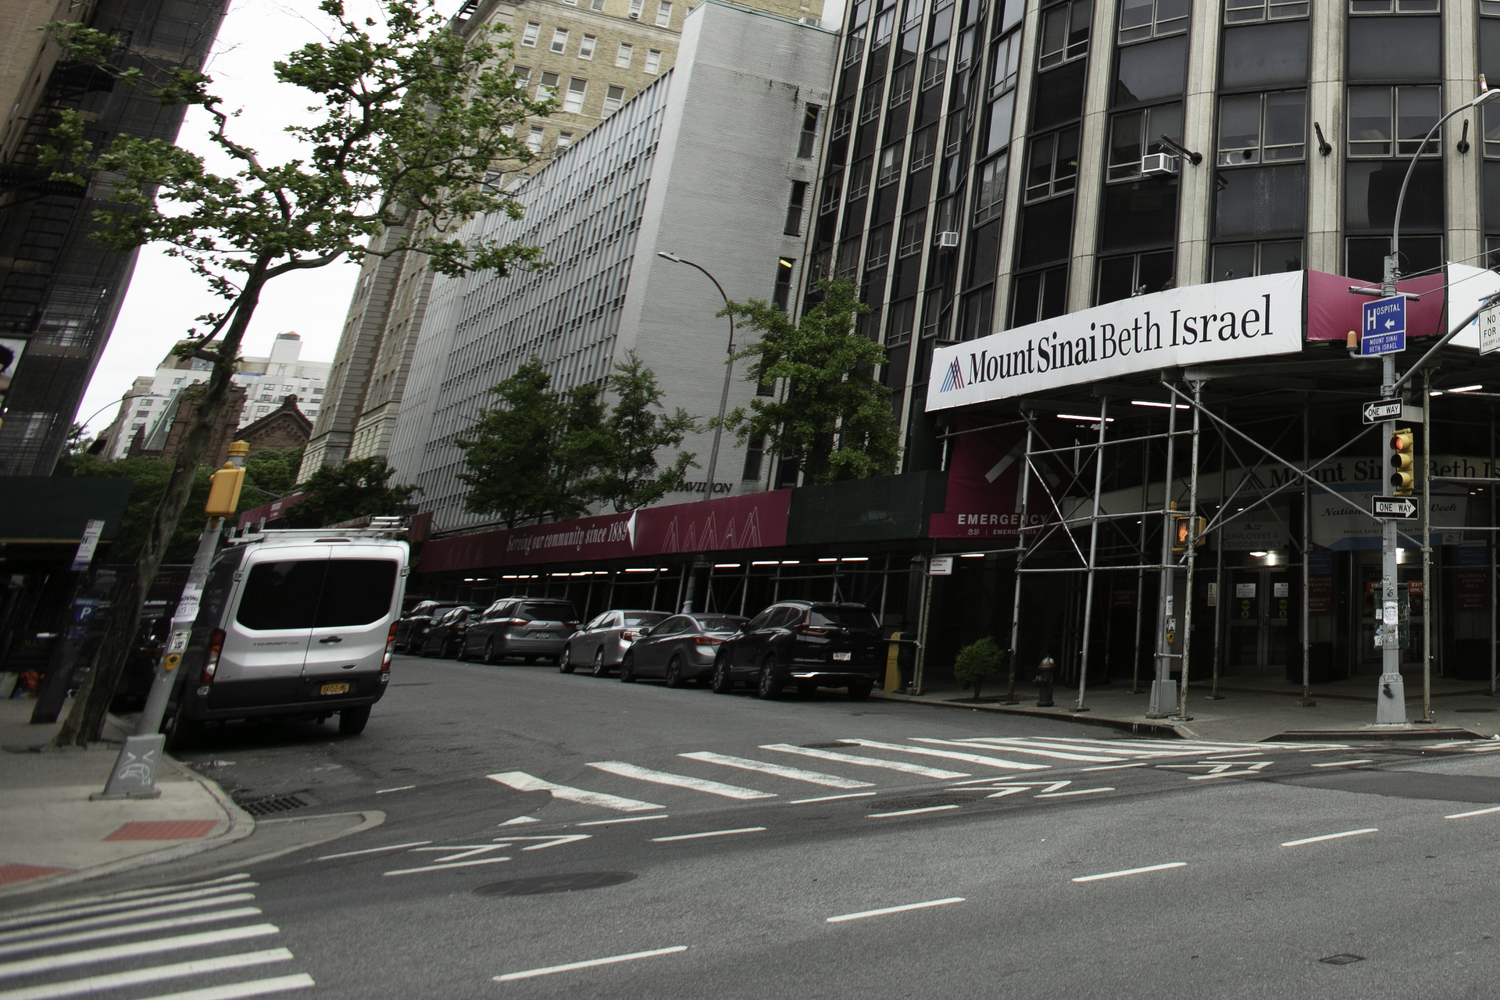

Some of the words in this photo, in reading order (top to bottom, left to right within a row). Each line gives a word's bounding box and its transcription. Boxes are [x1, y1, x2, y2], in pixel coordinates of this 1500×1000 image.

[1367, 303, 1401, 331] HOSPITAL
[1487, 314, 1496, 325] NO
[1483, 326, 1497, 338] FOR
[967, 338, 1036, 386] Mount
[1037, 322, 1098, 373] Sinai
[1100, 311, 1163, 361] Beth
[1169, 294, 1274, 348] Israel
[1369, 338, 1385, 346] MOUNT
[1386, 335, 1398, 343] SINAI
[1382, 343, 1397, 351] ISRAEL
[1368, 408, 1380, 417] ONE
[1386, 404, 1399, 414] WAY
[1269, 462, 1345, 488] Mount
[674, 481, 733, 494] PAVILON
[1380, 503, 1392, 511] ONE
[1398, 504, 1411, 512] WAY
[506, 534, 533, 556] Serving
[532, 536, 544, 550] our
[544, 526, 584, 551] community
[584, 524, 606, 544] since
[607, 520, 628, 542] 1889
[1226, 532, 1272, 540] EMPLOYEES
